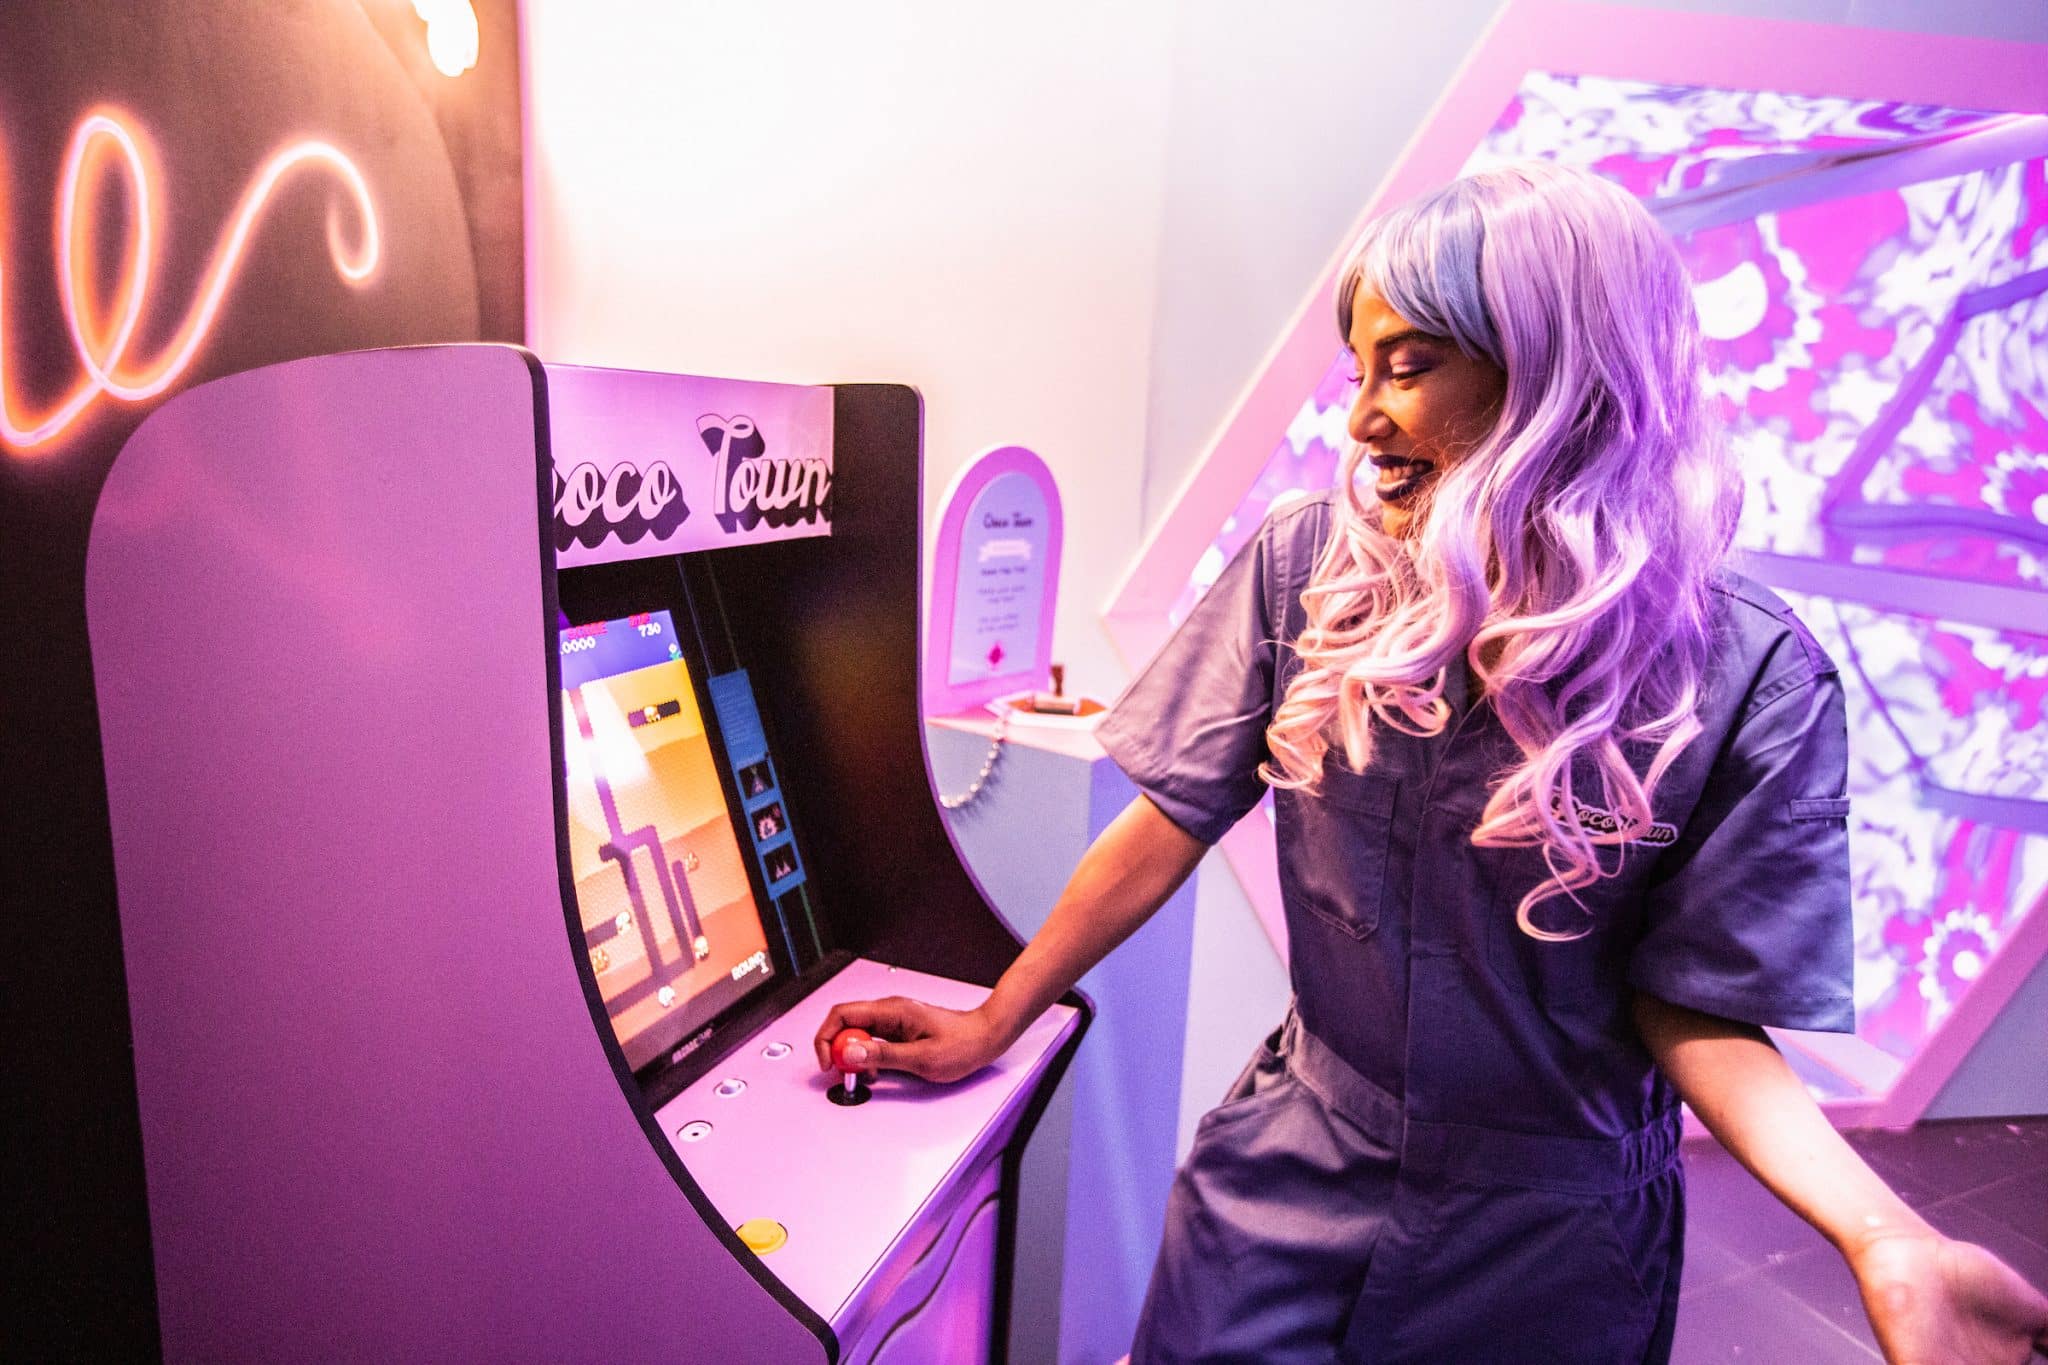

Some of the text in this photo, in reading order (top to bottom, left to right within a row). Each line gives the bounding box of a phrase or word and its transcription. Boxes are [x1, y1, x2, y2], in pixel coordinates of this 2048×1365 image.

[552, 412, 832, 552] oco Town
[560, 635, 597, 656] 0000
